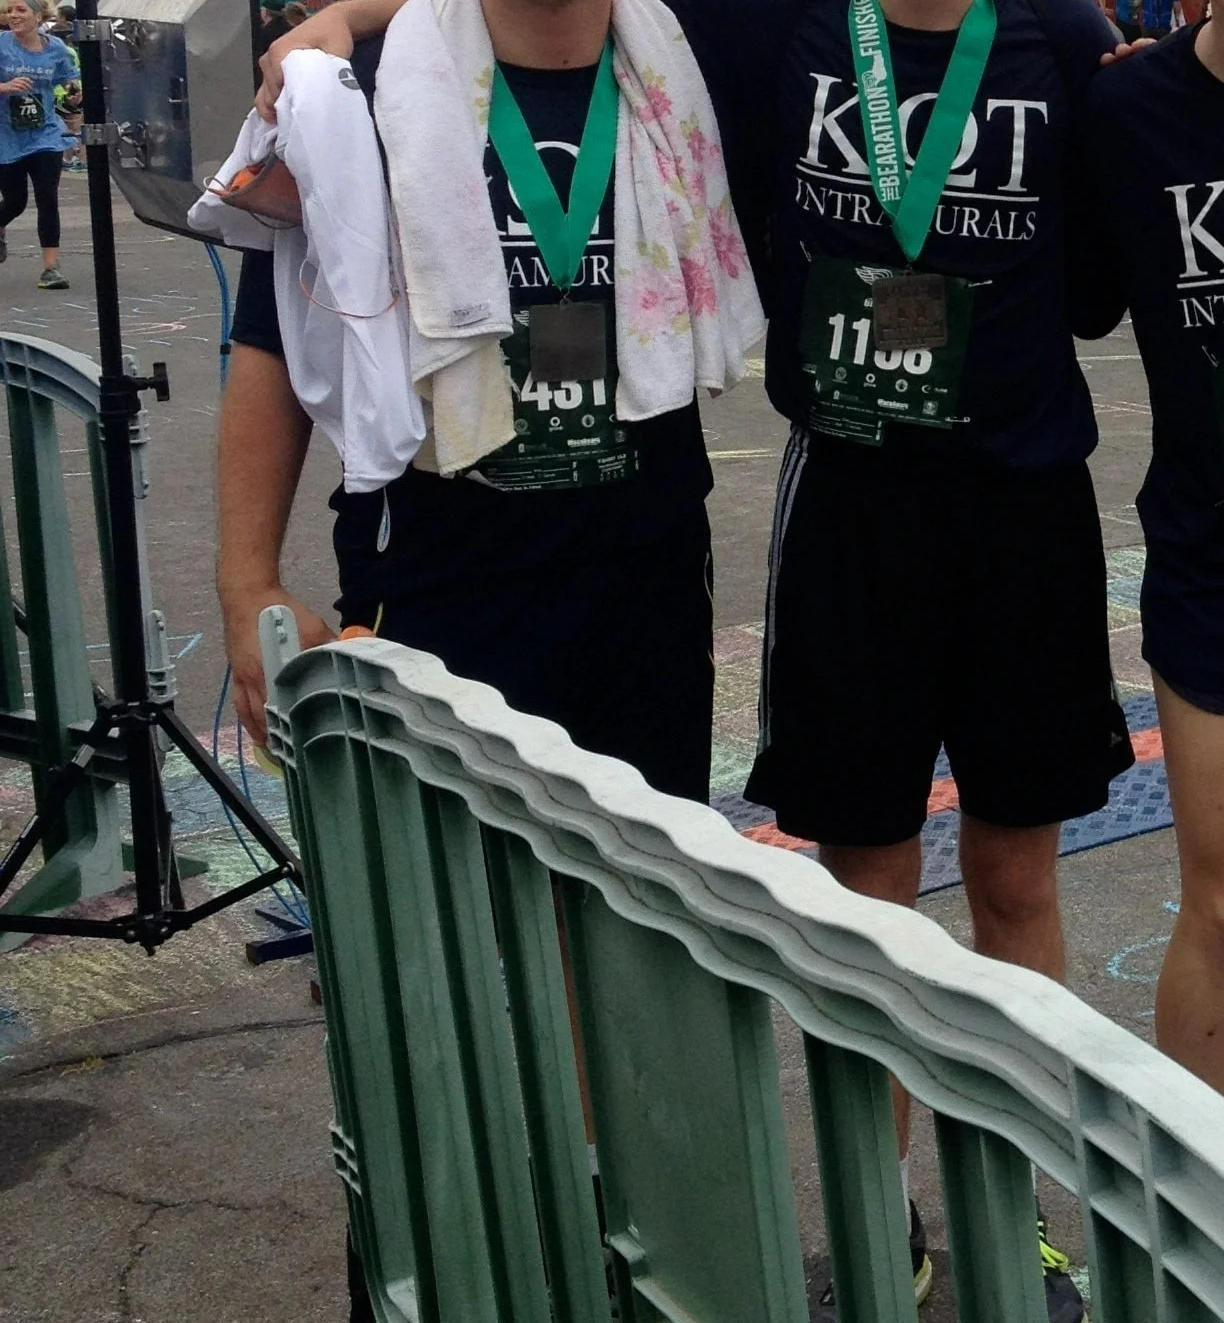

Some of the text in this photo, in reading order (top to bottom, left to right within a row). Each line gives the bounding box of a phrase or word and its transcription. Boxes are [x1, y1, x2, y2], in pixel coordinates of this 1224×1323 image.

[865, 85, 901, 187] BEARATHON
[795, 177, 1037, 241] INTRURALS
[521, 371, 607, 411] 431
